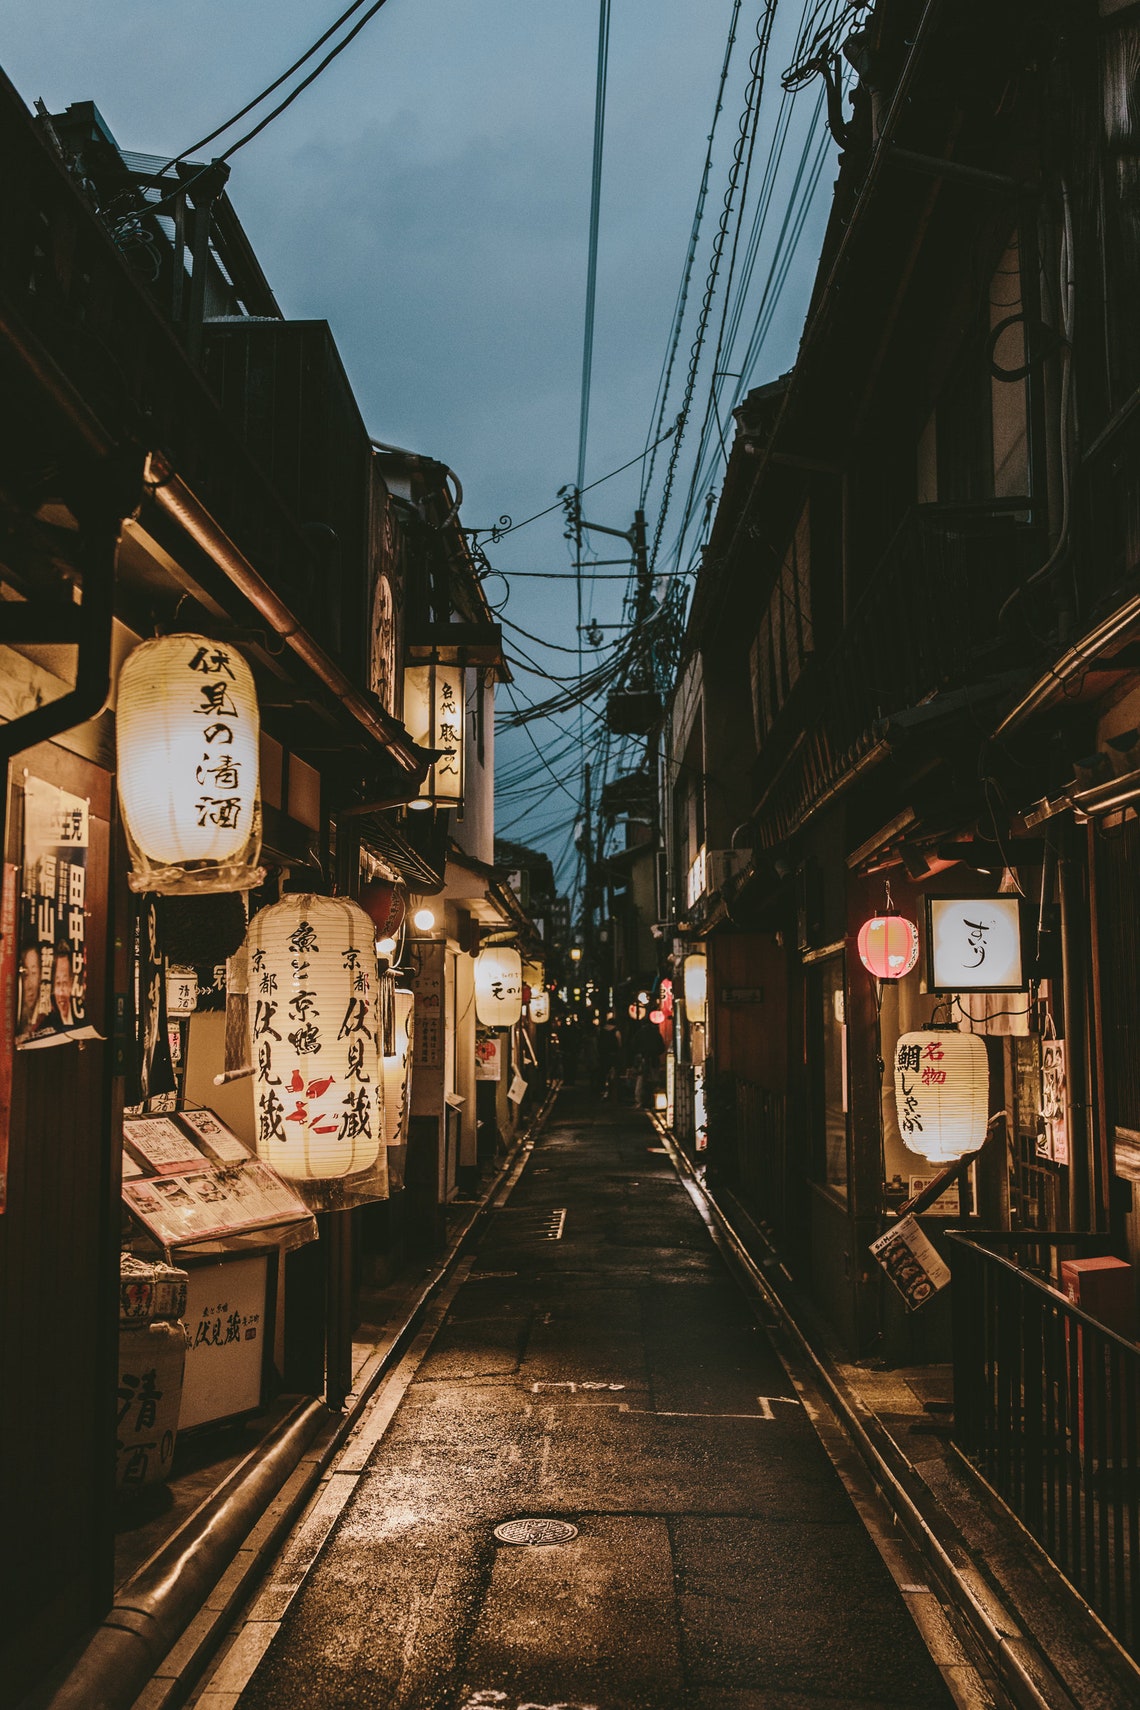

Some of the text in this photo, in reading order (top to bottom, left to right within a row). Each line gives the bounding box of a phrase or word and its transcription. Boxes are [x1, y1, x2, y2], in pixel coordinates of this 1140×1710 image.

[188, 647, 242, 829] 伏見の清酒
[286, 921, 322, 1056] 魚と京鴨
[897, 1044, 923, 1134] 鯛しゃぶ
[922, 1042, 947, 1086] 名物
